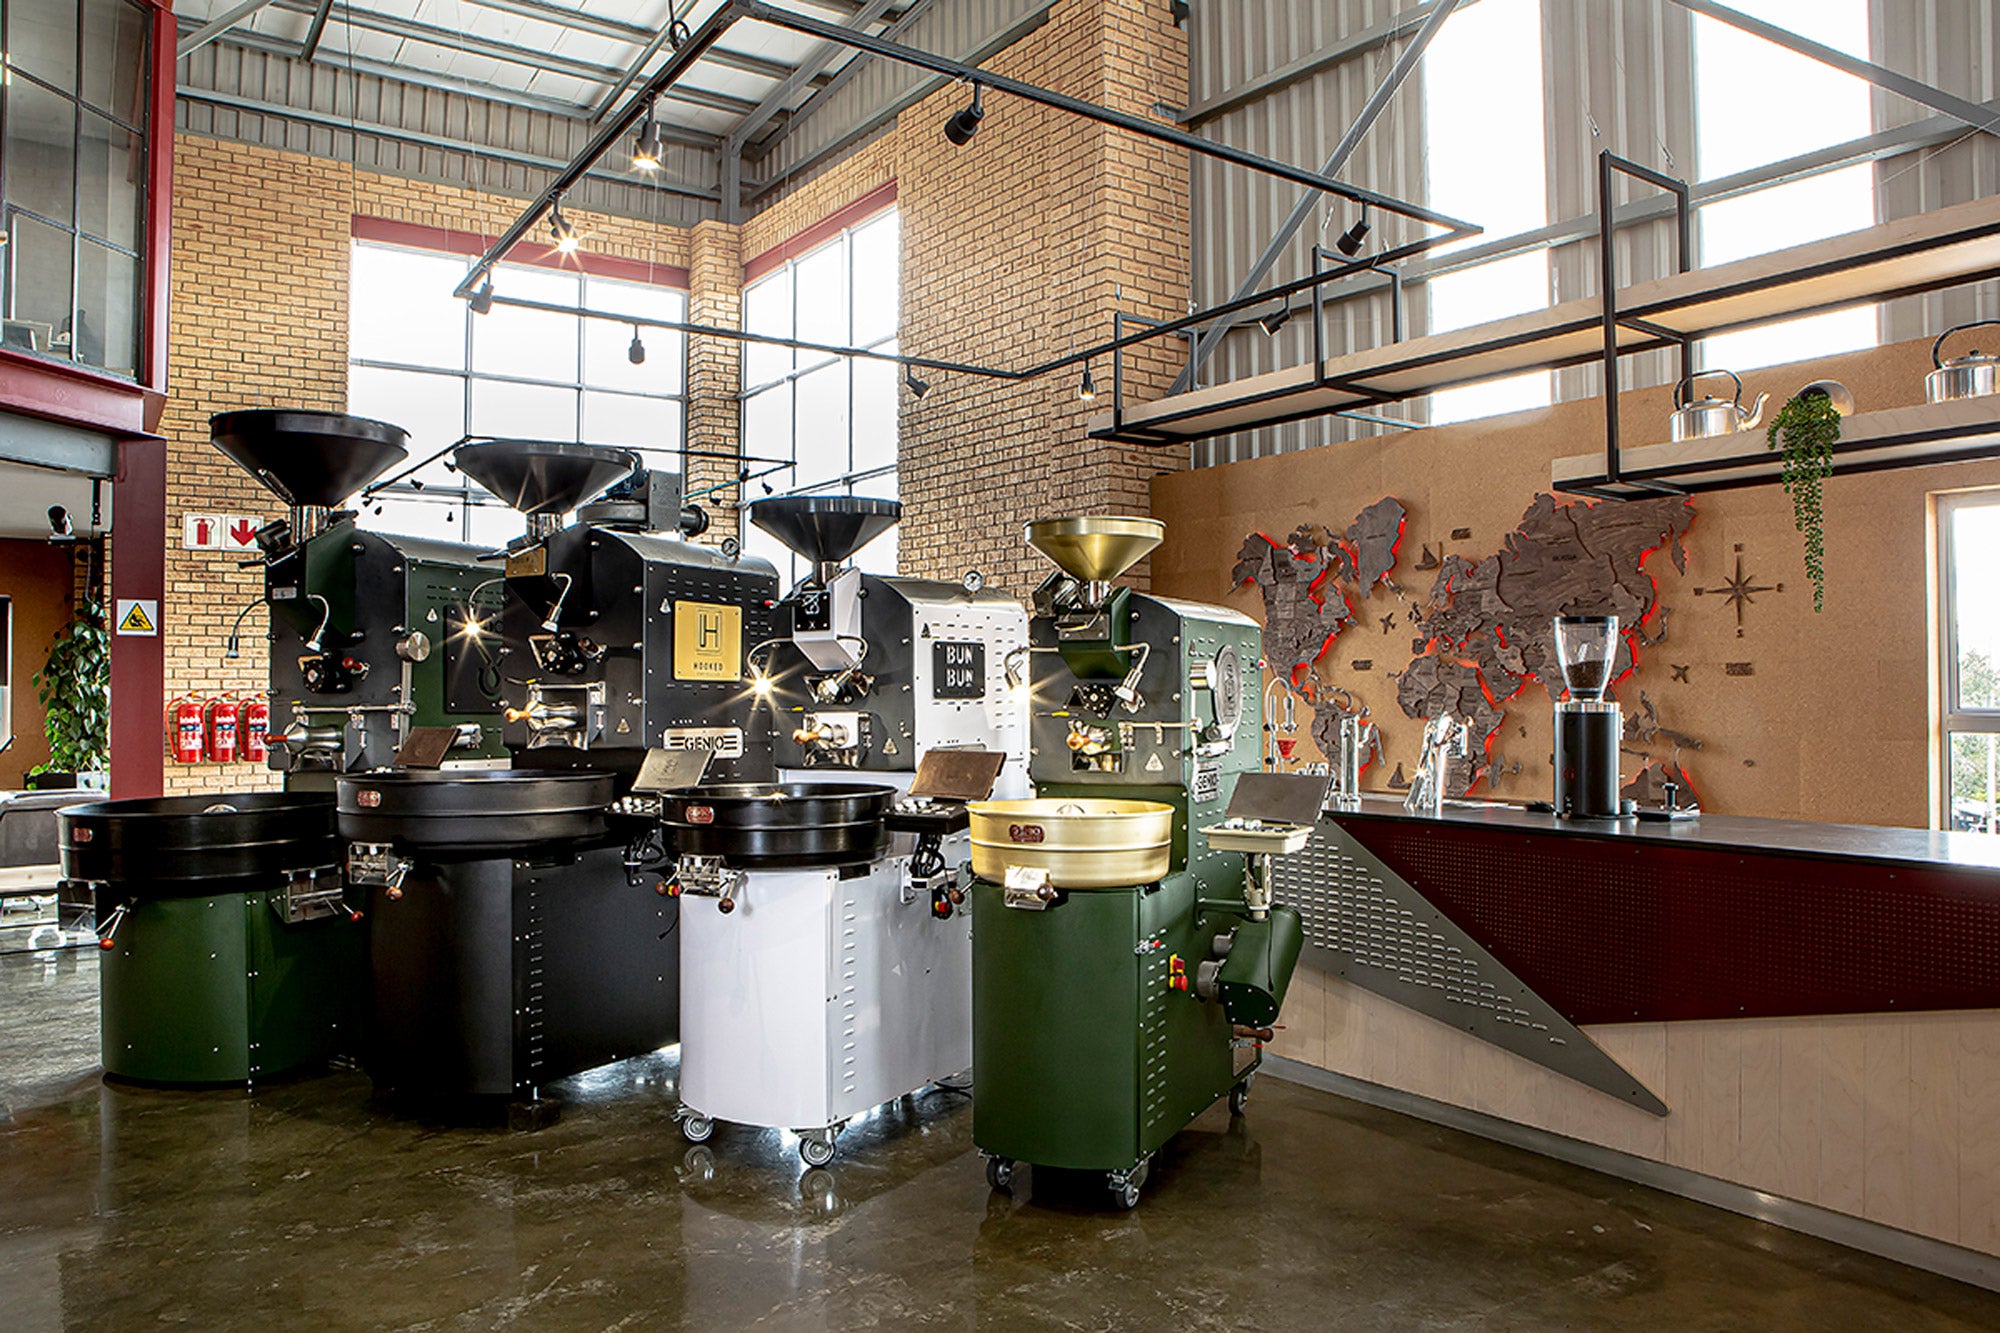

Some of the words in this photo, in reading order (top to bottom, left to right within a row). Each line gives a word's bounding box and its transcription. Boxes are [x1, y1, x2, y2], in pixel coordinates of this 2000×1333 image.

[1733, 543, 1744, 553] N
[1693, 587, 1705, 596] W
[1776, 582, 1785, 593] E
[1736, 628, 1744, 639] S
[946, 645, 974, 665] BUN
[693, 661, 724, 672] HOOKED
[946, 668, 974, 688] BUN
[684, 736, 725, 750] GENIO
